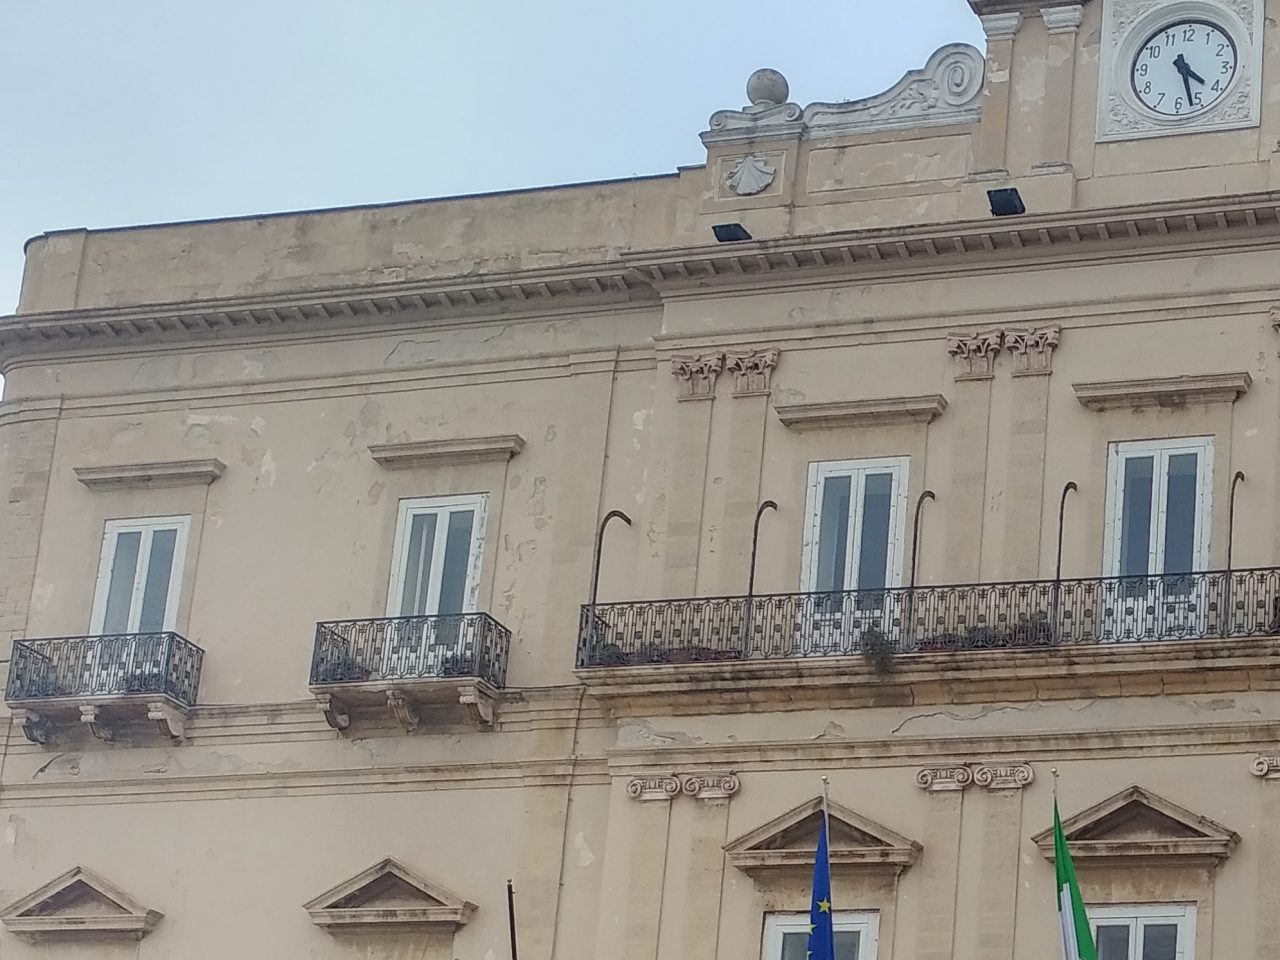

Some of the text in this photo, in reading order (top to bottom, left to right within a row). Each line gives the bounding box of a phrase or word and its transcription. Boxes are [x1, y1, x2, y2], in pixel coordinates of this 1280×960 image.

[1165, 33, 1176, 47] 11
[1182, 28, 1196, 42] 12
[1149, 45, 1161, 59] 10
[1215, 43, 1225, 57] 2
[1139, 63, 1148, 77] 9
[1220, 61, 1230, 74] 3
[1143, 81, 1152, 95] 8
[1210, 79, 1220, 93] 4
[1156, 92, 1166, 106] 7
[1174, 96, 1183, 110] 6
[1193, 91, 1203, 106] 5
